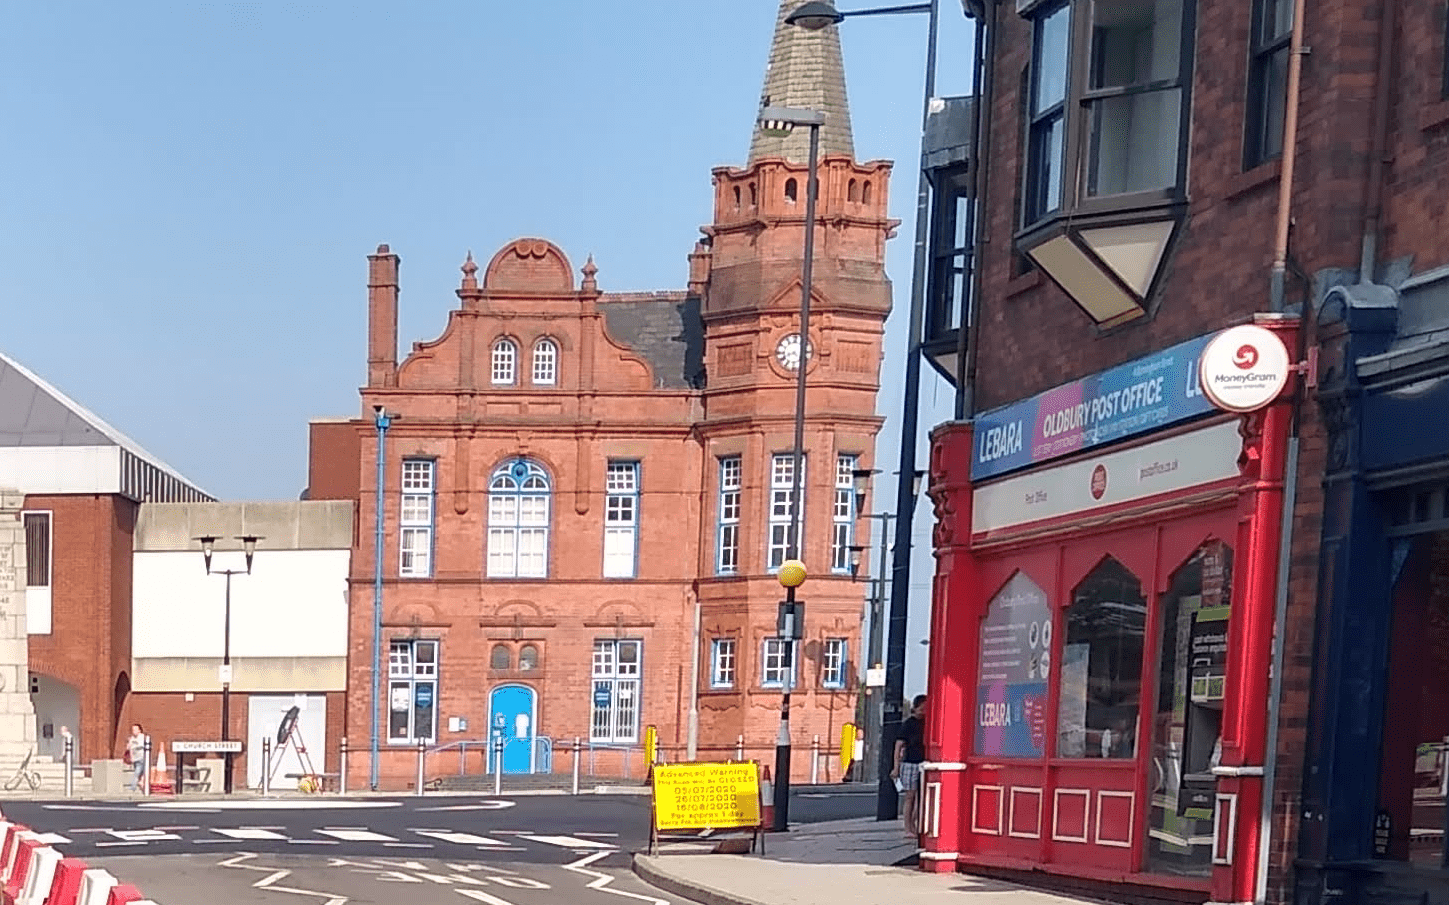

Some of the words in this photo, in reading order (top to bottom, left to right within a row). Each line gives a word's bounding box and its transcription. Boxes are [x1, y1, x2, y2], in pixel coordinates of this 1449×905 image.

[1215, 372, 1276, 383] MoneyGram
[1043, 401, 1092, 438] OLDBURY
[1091, 390, 1120, 422] POST
[1120, 376, 1164, 413] OFFICE
[979, 420, 1023, 463] LEBARA
[980, 703, 1011, 726] LEBARA
